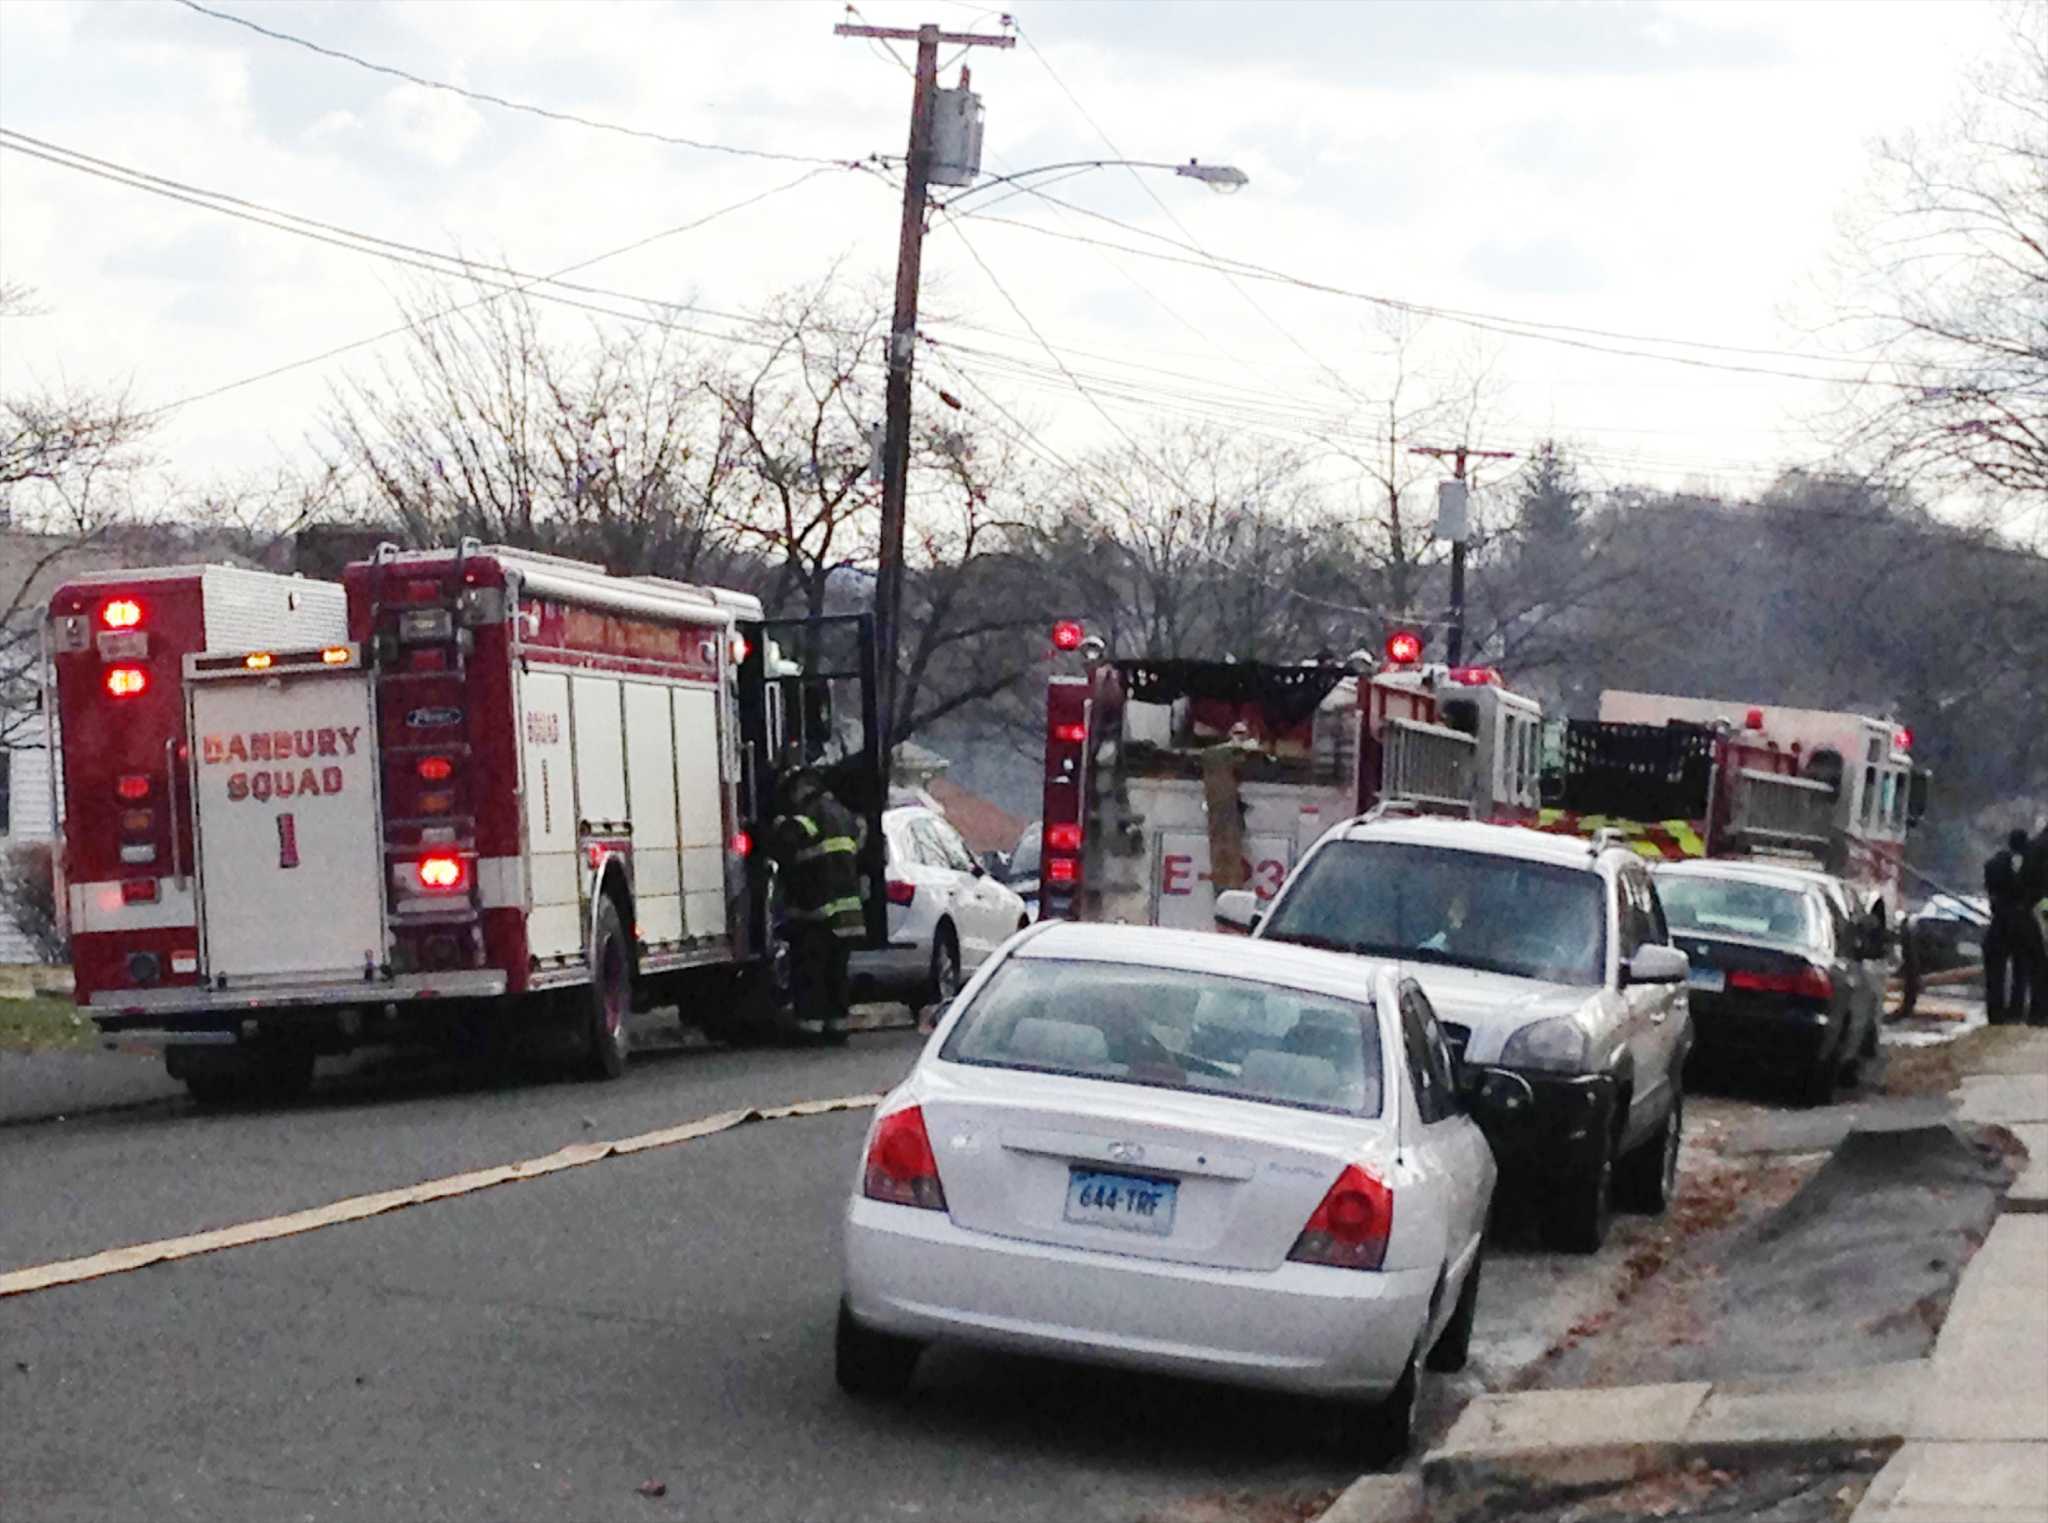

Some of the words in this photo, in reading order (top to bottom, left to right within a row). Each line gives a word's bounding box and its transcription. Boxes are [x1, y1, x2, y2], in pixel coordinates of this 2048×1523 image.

[203, 726, 361, 764] DANBURY
[227, 766, 343, 803] SQUAD
[276, 812, 300, 869] 1
[1079, 1184, 1163, 1217] 644-TRF
